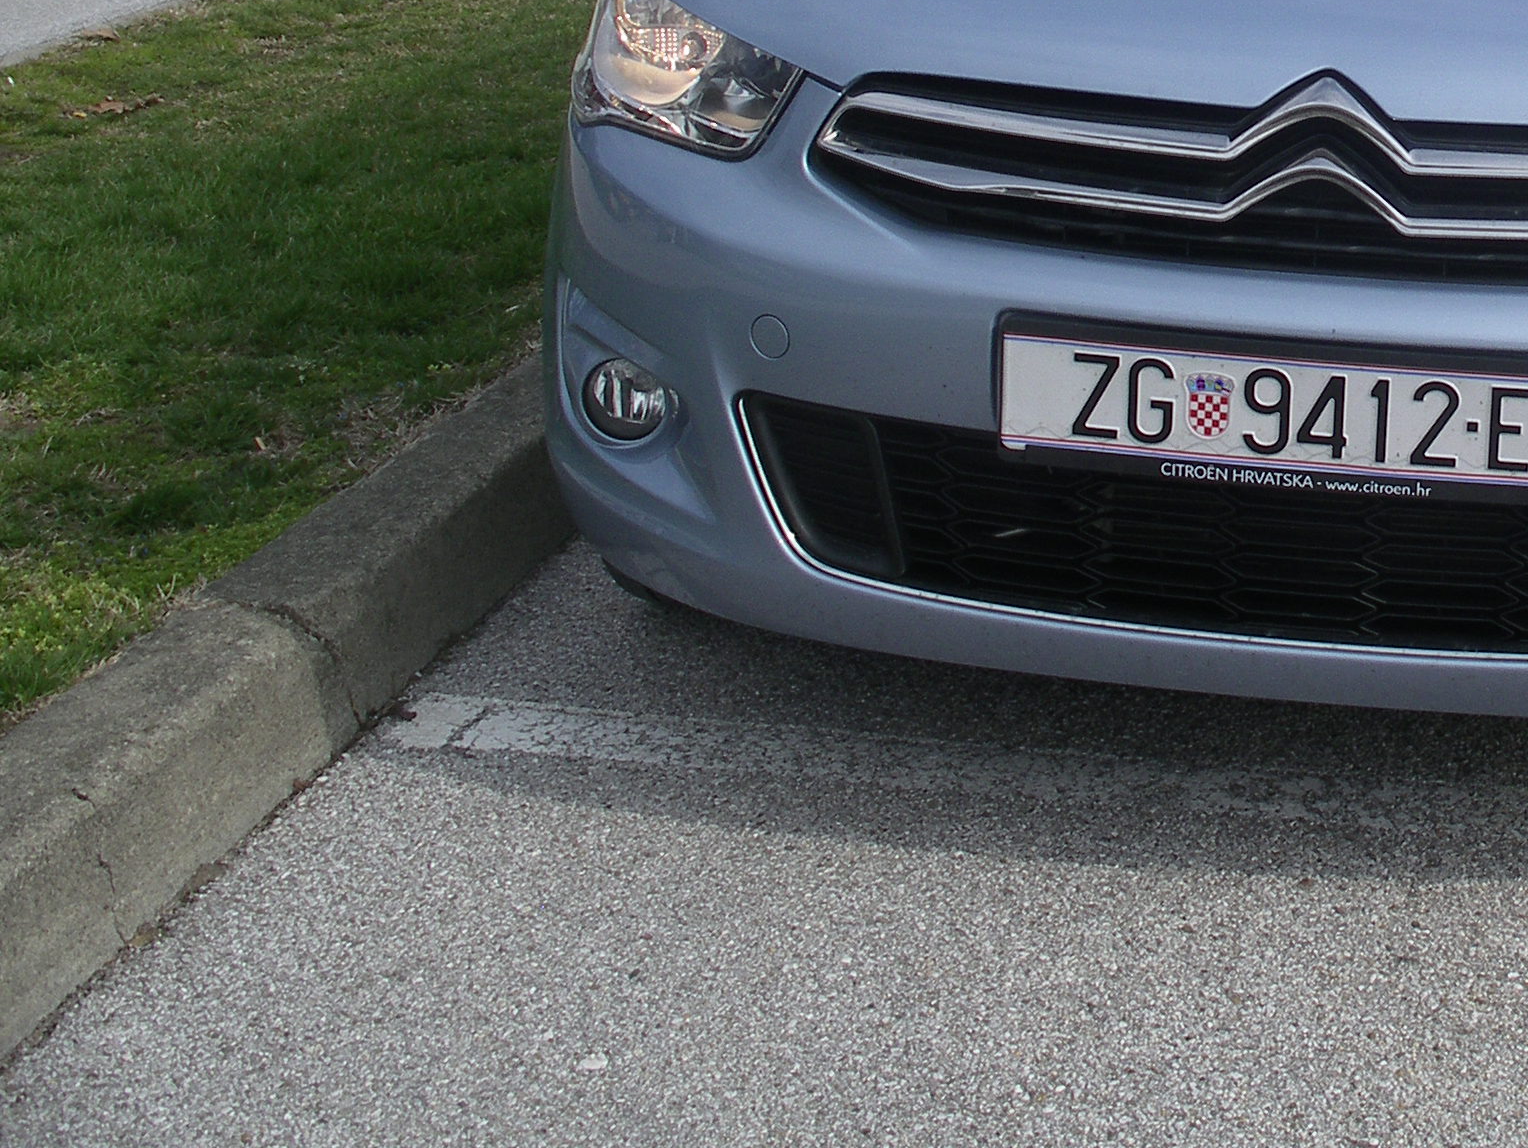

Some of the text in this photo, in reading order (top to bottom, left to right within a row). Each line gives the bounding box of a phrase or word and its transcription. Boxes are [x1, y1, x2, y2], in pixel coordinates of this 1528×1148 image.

[1072, 352, 1176, 444] ZG
[1160, 461, 1229, 482] CITROËN
[1232, 468, 1314, 489] HRVATSKA
[1325, 480, 1432, 497] www.citroen.hr
